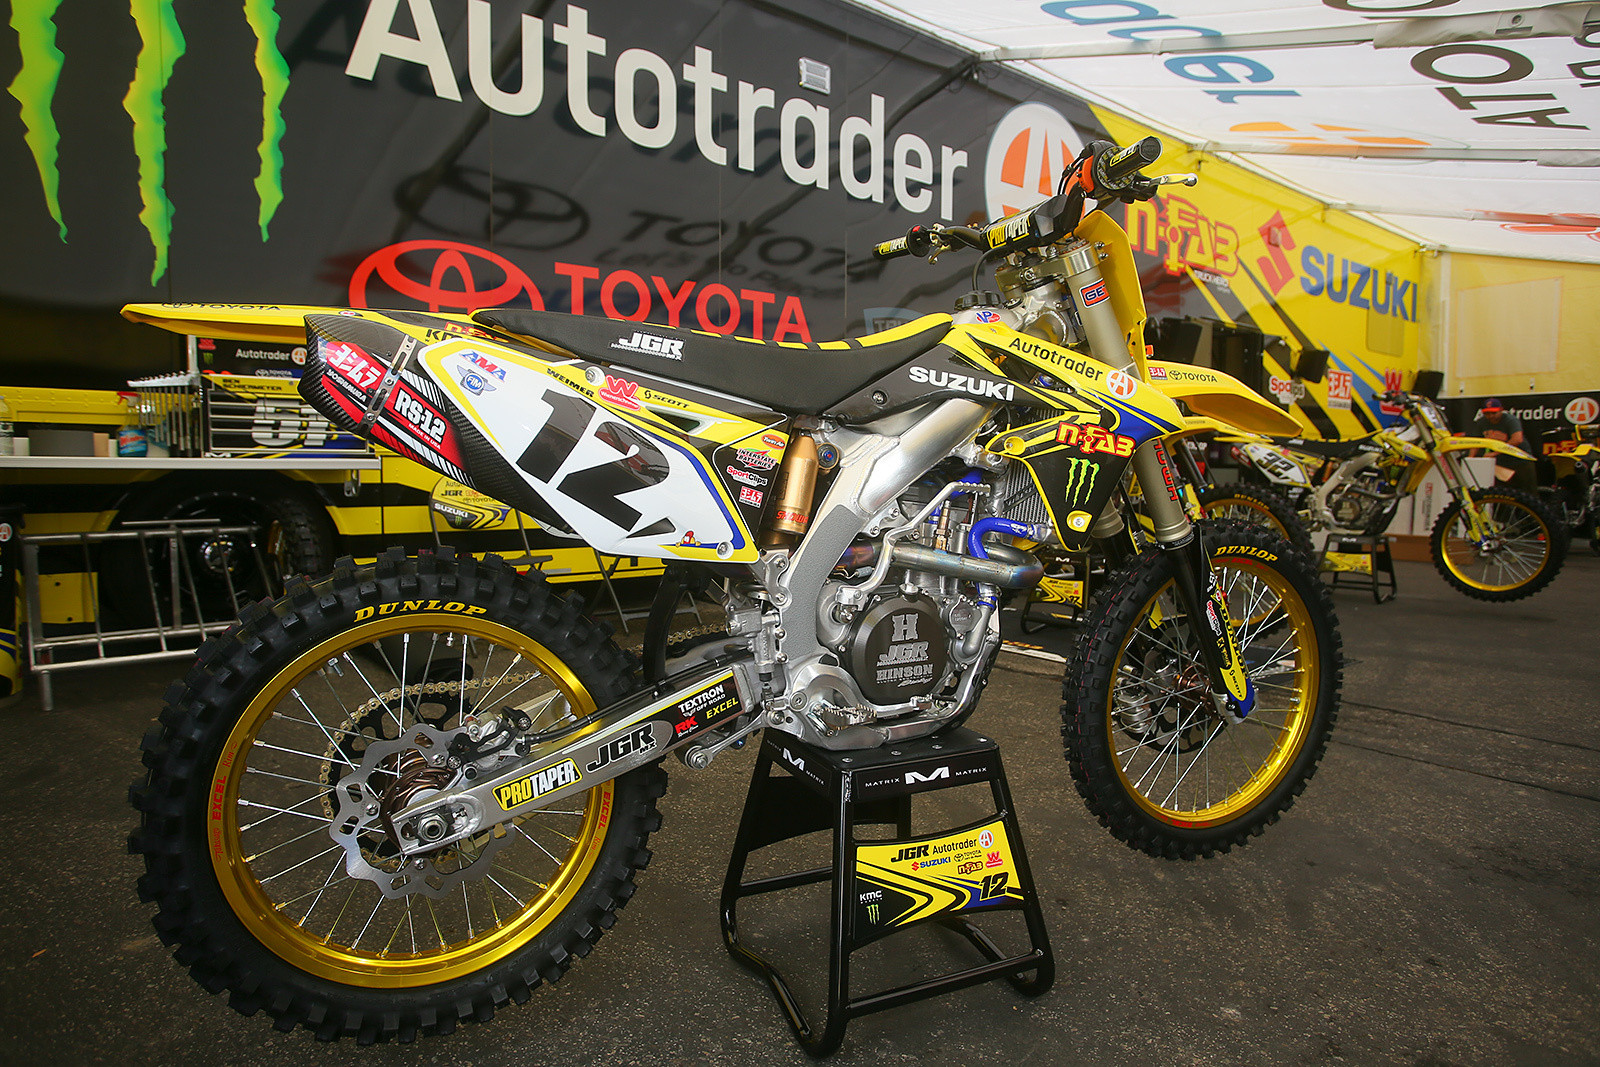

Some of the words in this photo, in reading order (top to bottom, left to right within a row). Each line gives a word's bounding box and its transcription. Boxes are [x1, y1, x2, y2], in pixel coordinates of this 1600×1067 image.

[345, 0, 968, 221] Autotrader
[1300, 245, 1418, 323] SUZUKI
[554, 261, 813, 343] TOYOTA
[236, 348, 291, 361] Autotrader
[618, 332, 684, 357] JGR
[462, 351, 507, 381] AMA
[1008, 337, 1103, 381] Autotrader
[546, 368, 595, 398] WEIMER
[908, 366, 1015, 402] SUZUKI
[1182, 372, 1218, 383] TOYOTA
[652, 394, 690, 409] SCOTT
[738, 449, 777, 464] INTERSTATE
[738, 455, 772, 469] BATTERIES
[434, 503, 469, 518] SUZUKI
[1214, 545, 1279, 561] DUNLOP
[353, 600, 487, 623] DUNLOP
[879, 641, 929, 662] JGR
[876, 664, 934, 681] HINSON
[678, 684, 724, 713] TEXTRON
[706, 697, 738, 719] EXCEL
[674, 716, 698, 734] RK
[586, 722, 655, 773] JGR
[500, 760, 577, 808] PROTAPER
[865, 778, 900, 788] MATRIX
[955, 767, 987, 776] MATRIX
[212, 775, 227, 821] EXCEL
[598, 792, 611, 830] EXCEL
[891, 845, 930, 863] JGR
[932, 838, 978, 855] Autotrader
[920, 856, 951, 868] SUZUKI
[980, 872, 1009, 900] 12
